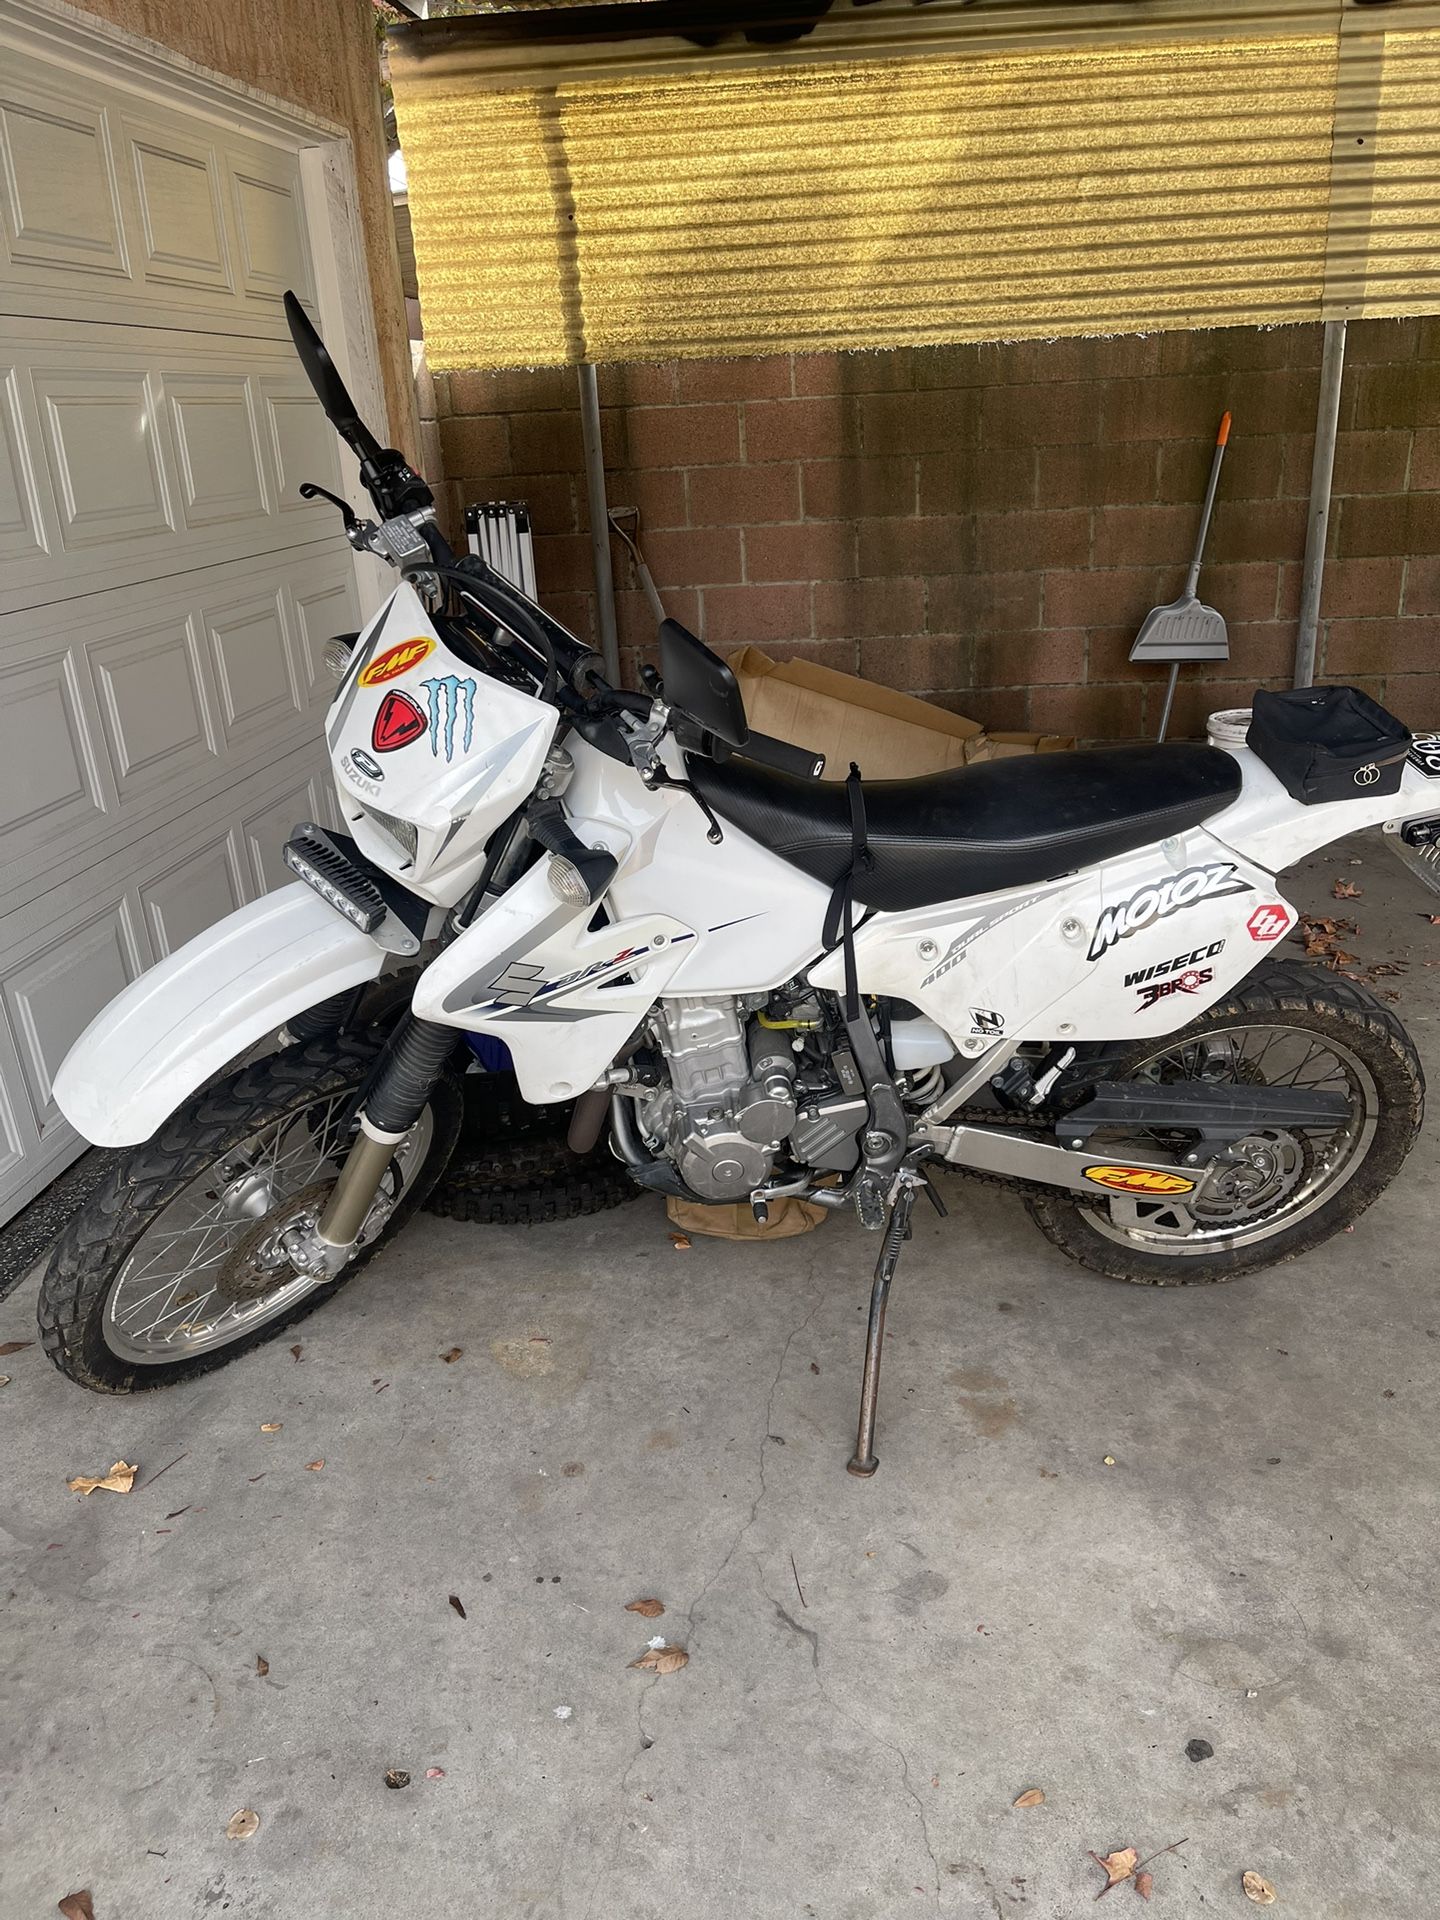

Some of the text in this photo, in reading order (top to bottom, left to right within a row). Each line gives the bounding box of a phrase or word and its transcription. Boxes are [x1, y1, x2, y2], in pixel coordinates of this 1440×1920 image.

[364, 642, 429, 684] FMF
[341, 756, 381, 798] SUZUKI
[919, 948, 967, 990] 400
[1123, 938, 1227, 988] WISECO
[1133, 966, 1214, 1015] 3BROS
[1085, 1167, 1195, 1190] FMF
